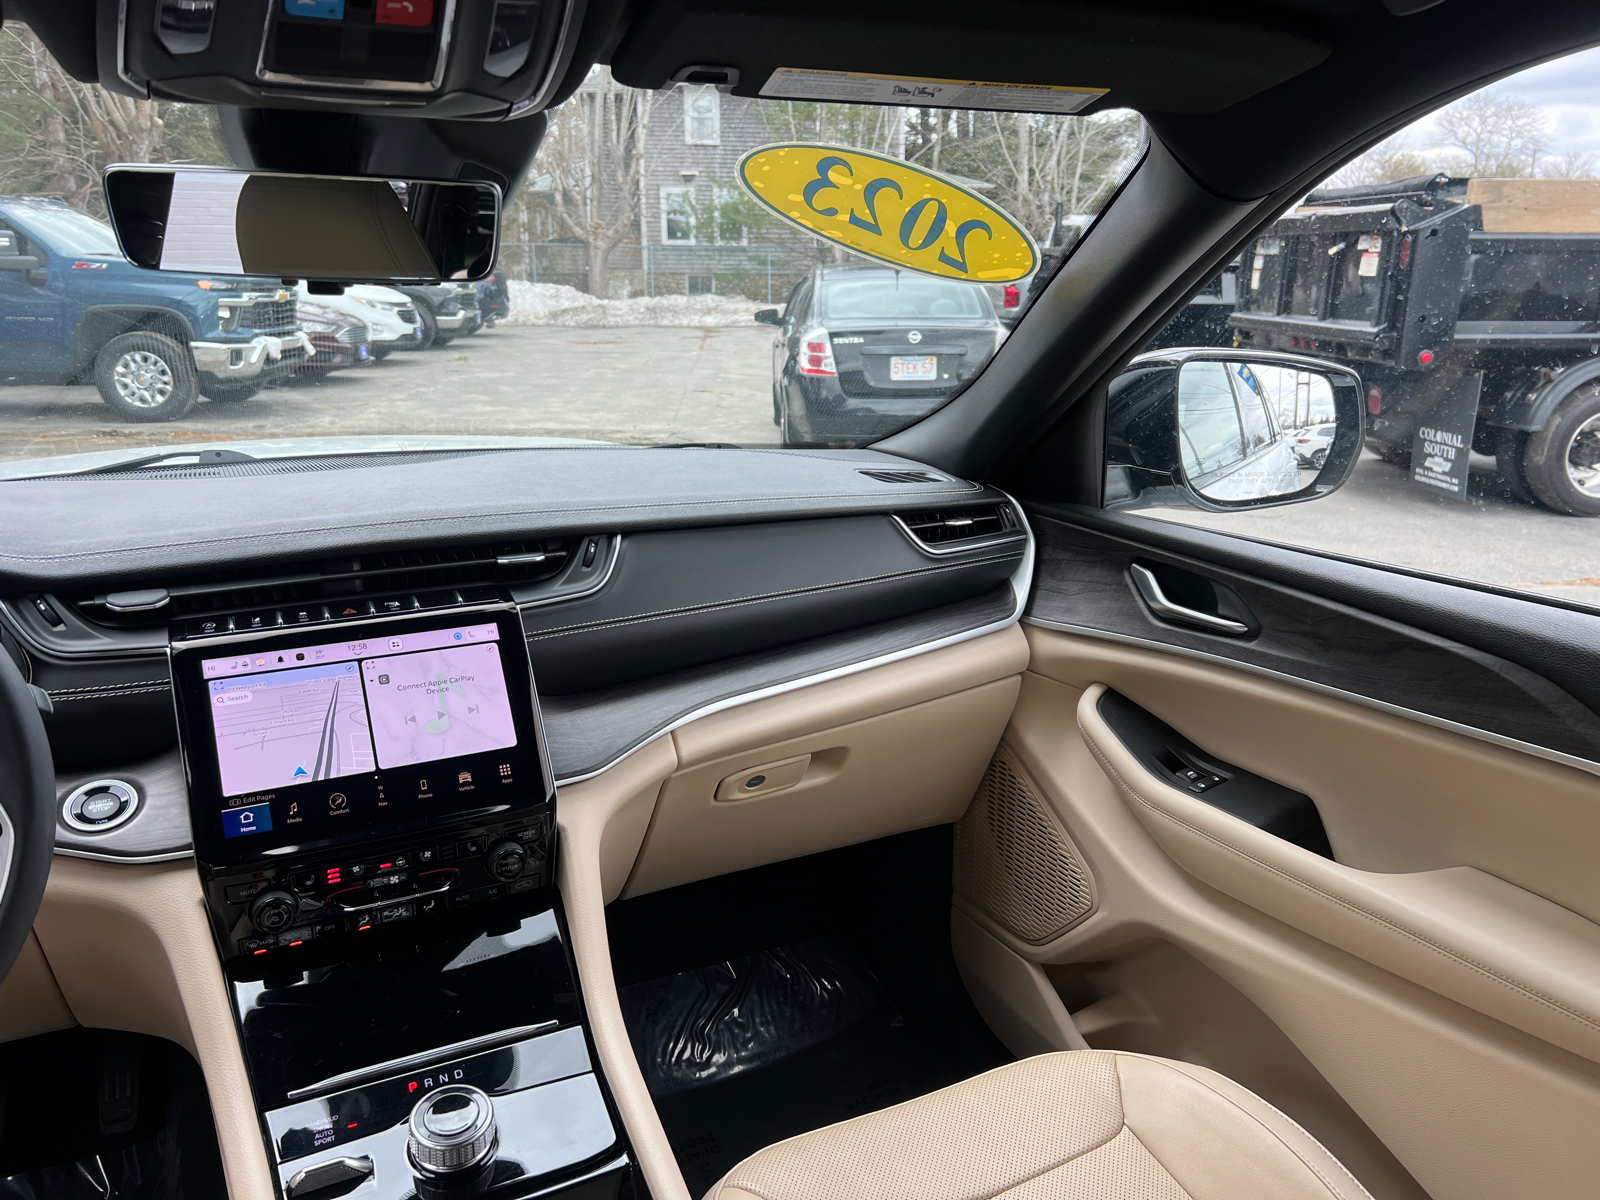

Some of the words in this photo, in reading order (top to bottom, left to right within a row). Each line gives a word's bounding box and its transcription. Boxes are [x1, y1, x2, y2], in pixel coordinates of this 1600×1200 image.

[893, 362, 918, 375] 5TEK
[921, 362, 935, 374] 57
[1419, 426, 1463, 448] COLONIAL
[1424, 441, 1456, 460] SOUTH
[347, 642, 368, 652] 12:58
[397, 682, 427, 692] Connect
[428, 678, 448, 689] Apple
[449, 674, 475, 684] CarPlay
[426, 686, 450, 695] Device
[227, 693, 249, 702] Search
[458, 784, 475, 792] Vehicle
[243, 796, 256, 804] Edit
[256, 793, 276, 802] Pages
[329, 808, 350, 816] Comfort
[286, 816, 303, 824] Media
[240, 825, 256, 833] Home
[517, 829, 536, 838] SCREEN
[240, 888, 257, 896] MUTE
[408, 1081, 418, 1093] P
[424, 1078, 434, 1088] R
[439, 1073, 449, 1084] N
[454, 1069, 464, 1080] D
[314, 1130, 334, 1140] AUTO
[313, 1135, 336, 1147] SPORT
